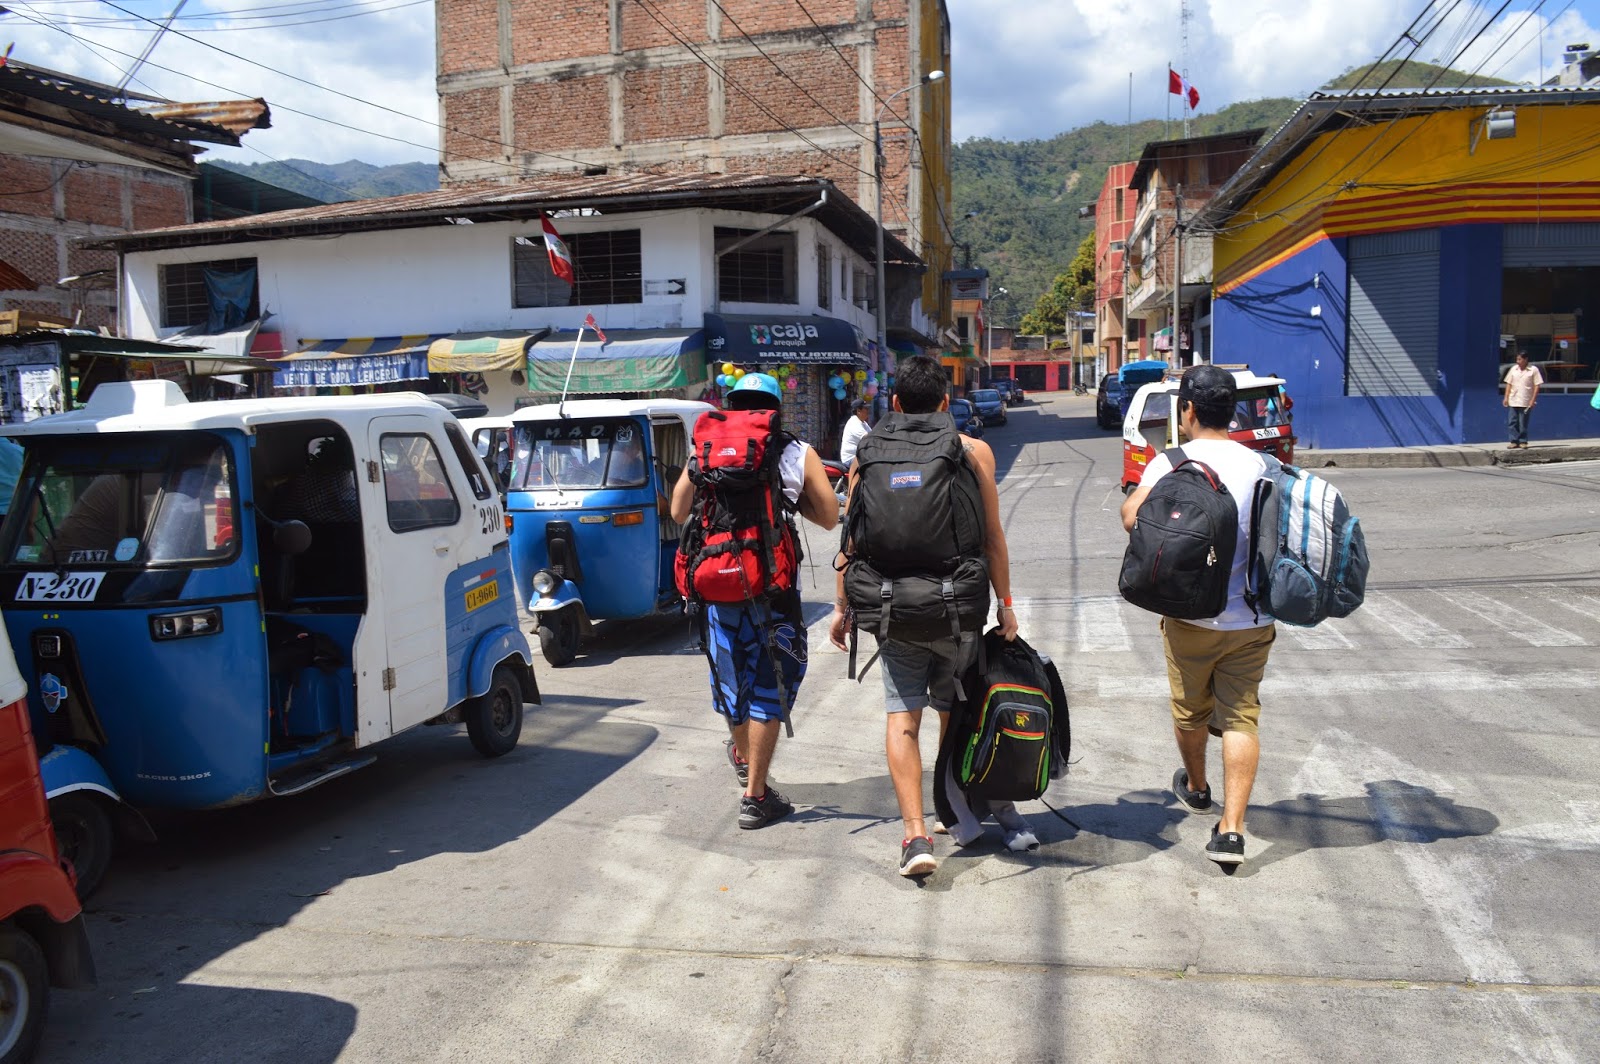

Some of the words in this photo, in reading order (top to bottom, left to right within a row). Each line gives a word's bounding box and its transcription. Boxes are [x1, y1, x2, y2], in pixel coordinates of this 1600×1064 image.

[771, 322, 819, 341] caja
[290, 359, 333, 371] NOVEDADES
[283, 373, 309, 385] VENTA
[315, 373, 326, 384] DE
[330, 371, 351, 384] ROPA
[357, 367, 399, 382] LENCERIA
[1129, 413, 1135, 422] S
[1124, 426, 1136, 438] 607
[472, 473, 484, 493] N
[480, 504, 501, 535] 230
[71, 551, 107, 562] TAXI
[17, 577, 96, 599] N-230
[137, 773, 177, 781] RACING
[179, 771, 212, 781] SHOX
